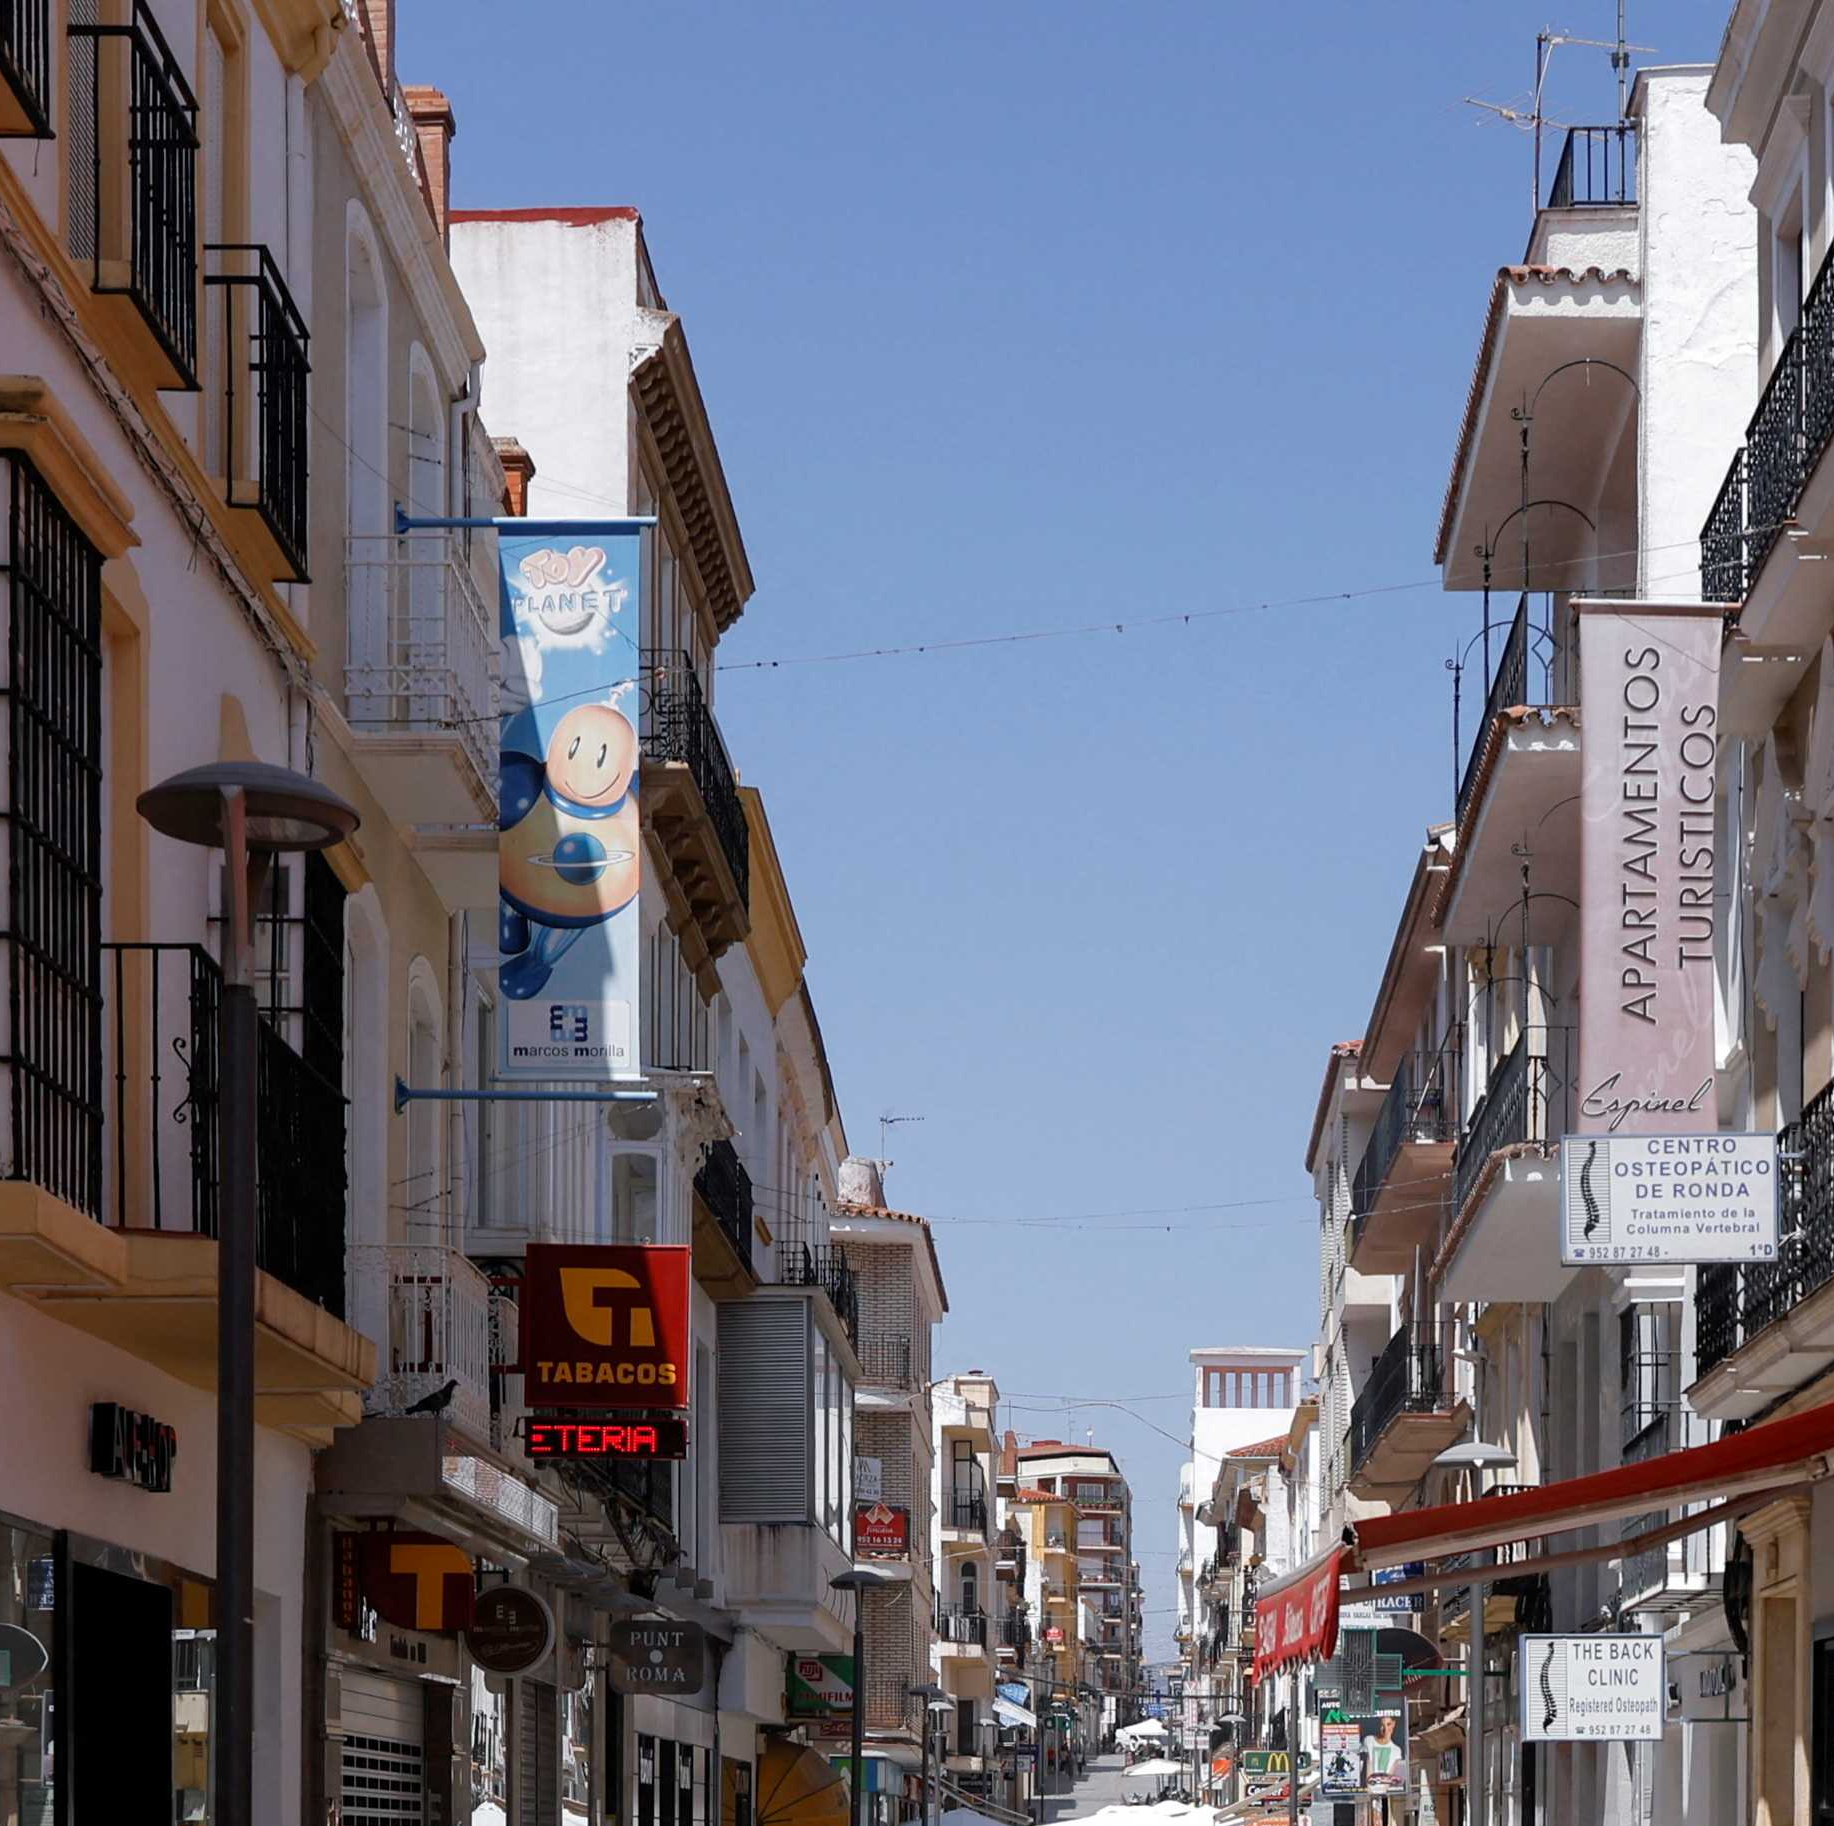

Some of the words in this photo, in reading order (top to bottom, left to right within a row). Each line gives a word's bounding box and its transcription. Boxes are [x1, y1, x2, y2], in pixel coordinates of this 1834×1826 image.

[520, 546, 606, 589] TOY
[513, 589, 622, 613] PLANET
[1622, 648, 1661, 1024] APARTAMENTOS
[1679, 704, 1716, 969] TURISTICOS
[514, 1046, 569, 1057] marcos
[574, 1044, 624, 1057] morilla
[1581, 1071, 1712, 1130] Espinel
[1647, 1139, 1737, 1154] CENTRO
[1614, 1157, 1771, 1177] OSTEOPÁTICO
[1636, 1184, 1663, 1199] DE
[1673, 1182, 1750, 1198] RONDA
[1631, 1208, 1716, 1220] Tratamiento
[1721, 1208, 1738, 1219] de
[1744, 1208, 1756, 1218] la
[1626, 1223, 1690, 1235] Columna
[1696, 1222, 1760, 1233] Vertebral
[1589, 1246, 1609, 1258] 952
[1613, 1246, 1626, 1258] 87
[1631, 1246, 1643, 1257] 27
[1647, 1246, 1660, 1257] 48
[537, 1361, 677, 1385] TABACOS
[631, 1631, 685, 1647] PUNT
[1573, 1643, 1603, 1660] THE
[1609, 1642, 1654, 1660] BACK
[626, 1665, 686, 1683] ROMA
[1588, 1668, 1639, 1686] CLINIC
[1569, 1697, 1613, 1717] Registered
[1615, 1697, 1658, 1717] Osteopath
[1589, 1725, 1606, 1735] 952
[1625, 1725, 1636, 1735] 27
